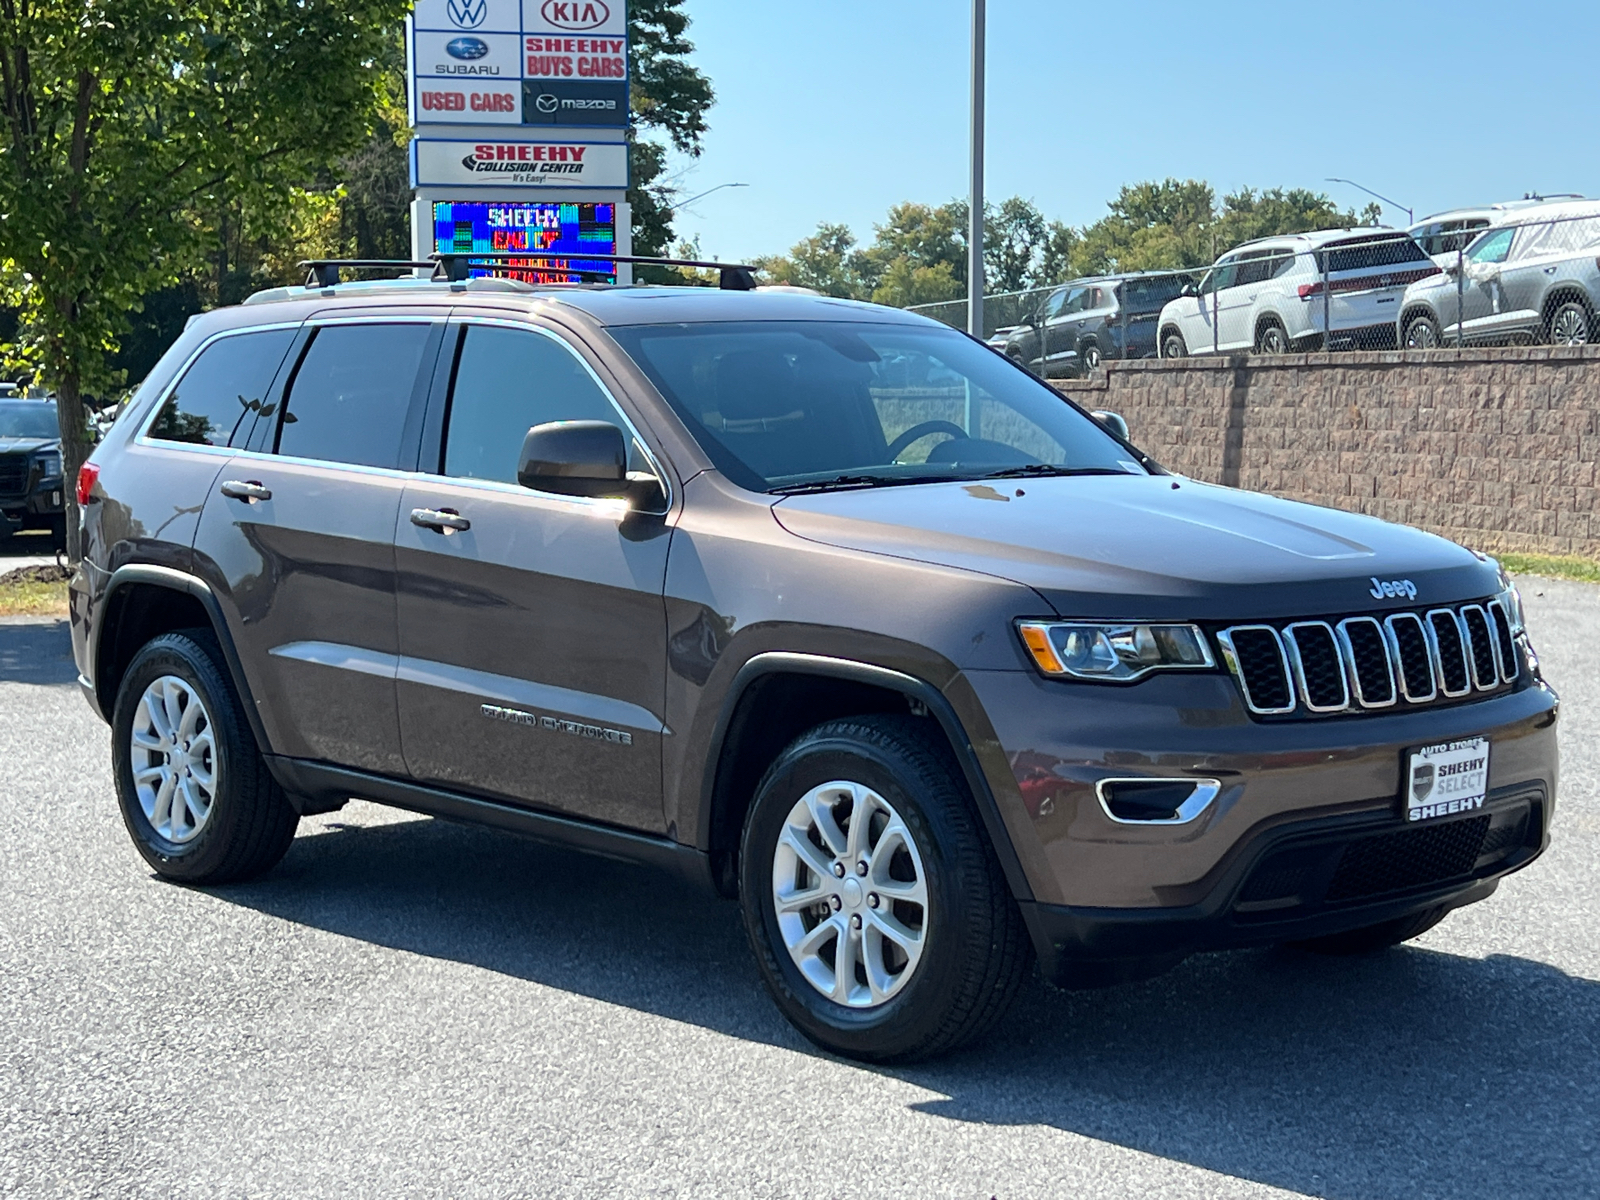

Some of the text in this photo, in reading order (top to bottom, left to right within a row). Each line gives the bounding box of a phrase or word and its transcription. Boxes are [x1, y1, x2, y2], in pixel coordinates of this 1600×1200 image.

[553, 3, 598, 22] KIA
[526, 38, 624, 53] SHEEHY
[435, 65, 499, 75] SUBARU
[527, 56, 625, 77] BUYS CARS
[422, 92, 515, 112] USED CARS
[561, 99, 616, 109] mazda
[475, 145, 586, 162] SHEEHY
[475, 161, 584, 174] COLLISION CENTER
[512, 173, 547, 184] It's Easy!
[1369, 577, 1417, 601] Jeep
[540, 716, 633, 745] CHEROKEE
[1420, 743, 1447, 755] AUTO
[1439, 757, 1485, 777] SHEEHY
[1438, 771, 1484, 794] SELECT
[1409, 795, 1485, 821] SHEEHY
